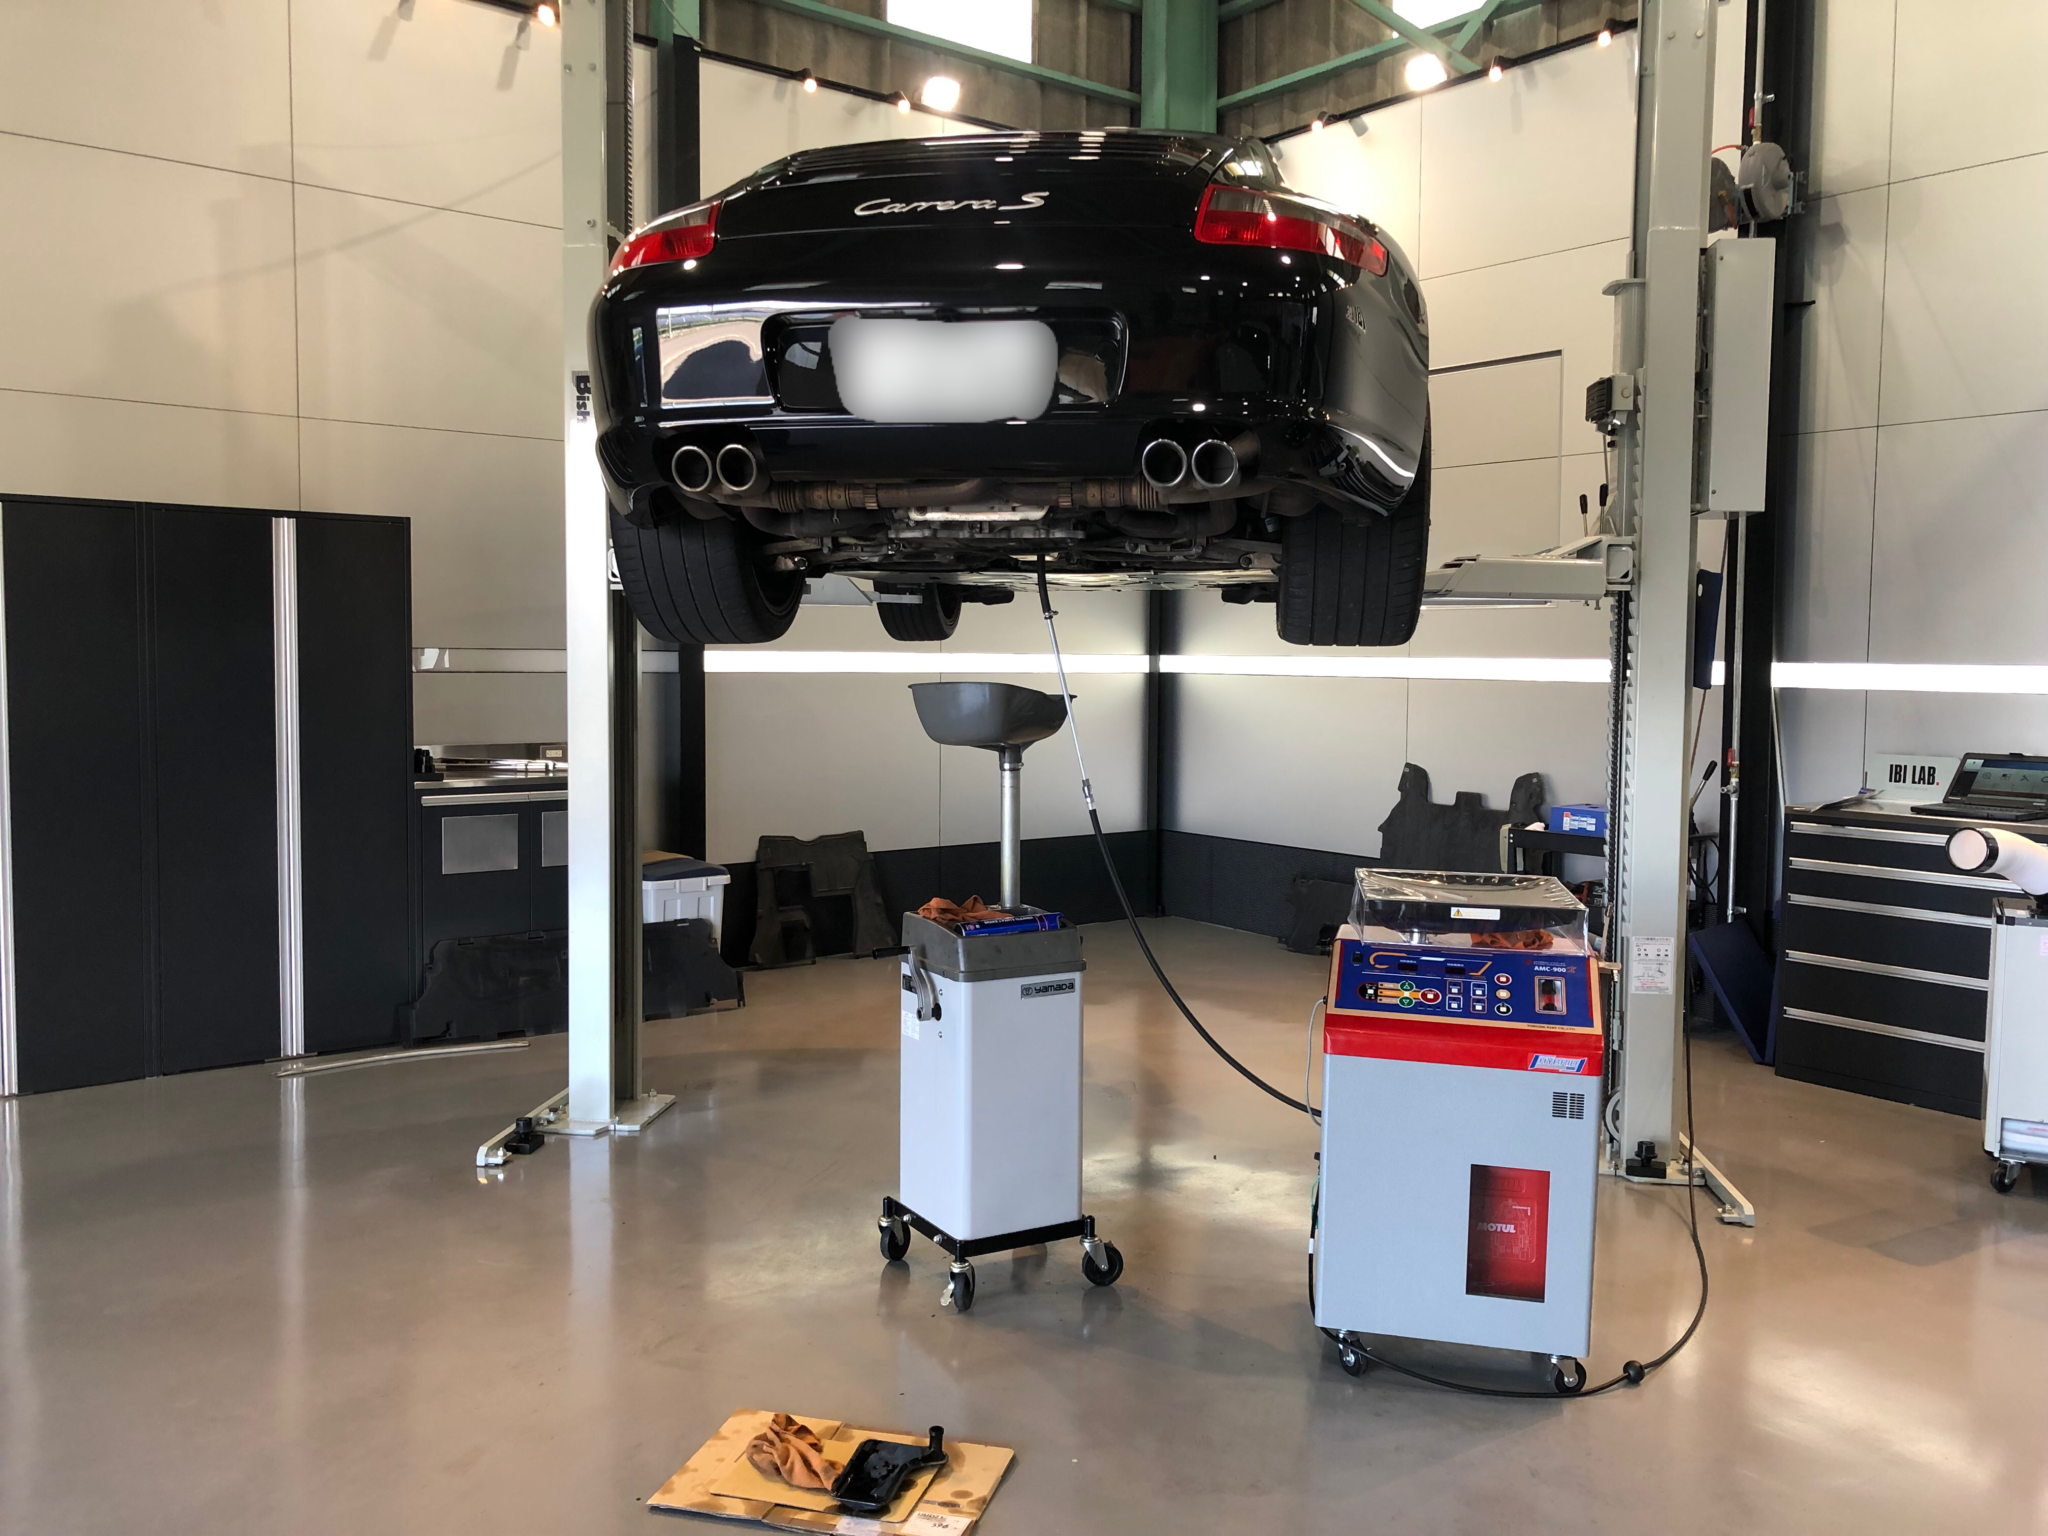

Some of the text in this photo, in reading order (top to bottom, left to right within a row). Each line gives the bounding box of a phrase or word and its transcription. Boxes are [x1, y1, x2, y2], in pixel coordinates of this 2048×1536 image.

[854, 191, 1050, 216] Carrera S
[1888, 764, 1940, 786] IBI LAB.
[1476, 1222, 1516, 1234] MOTUL
